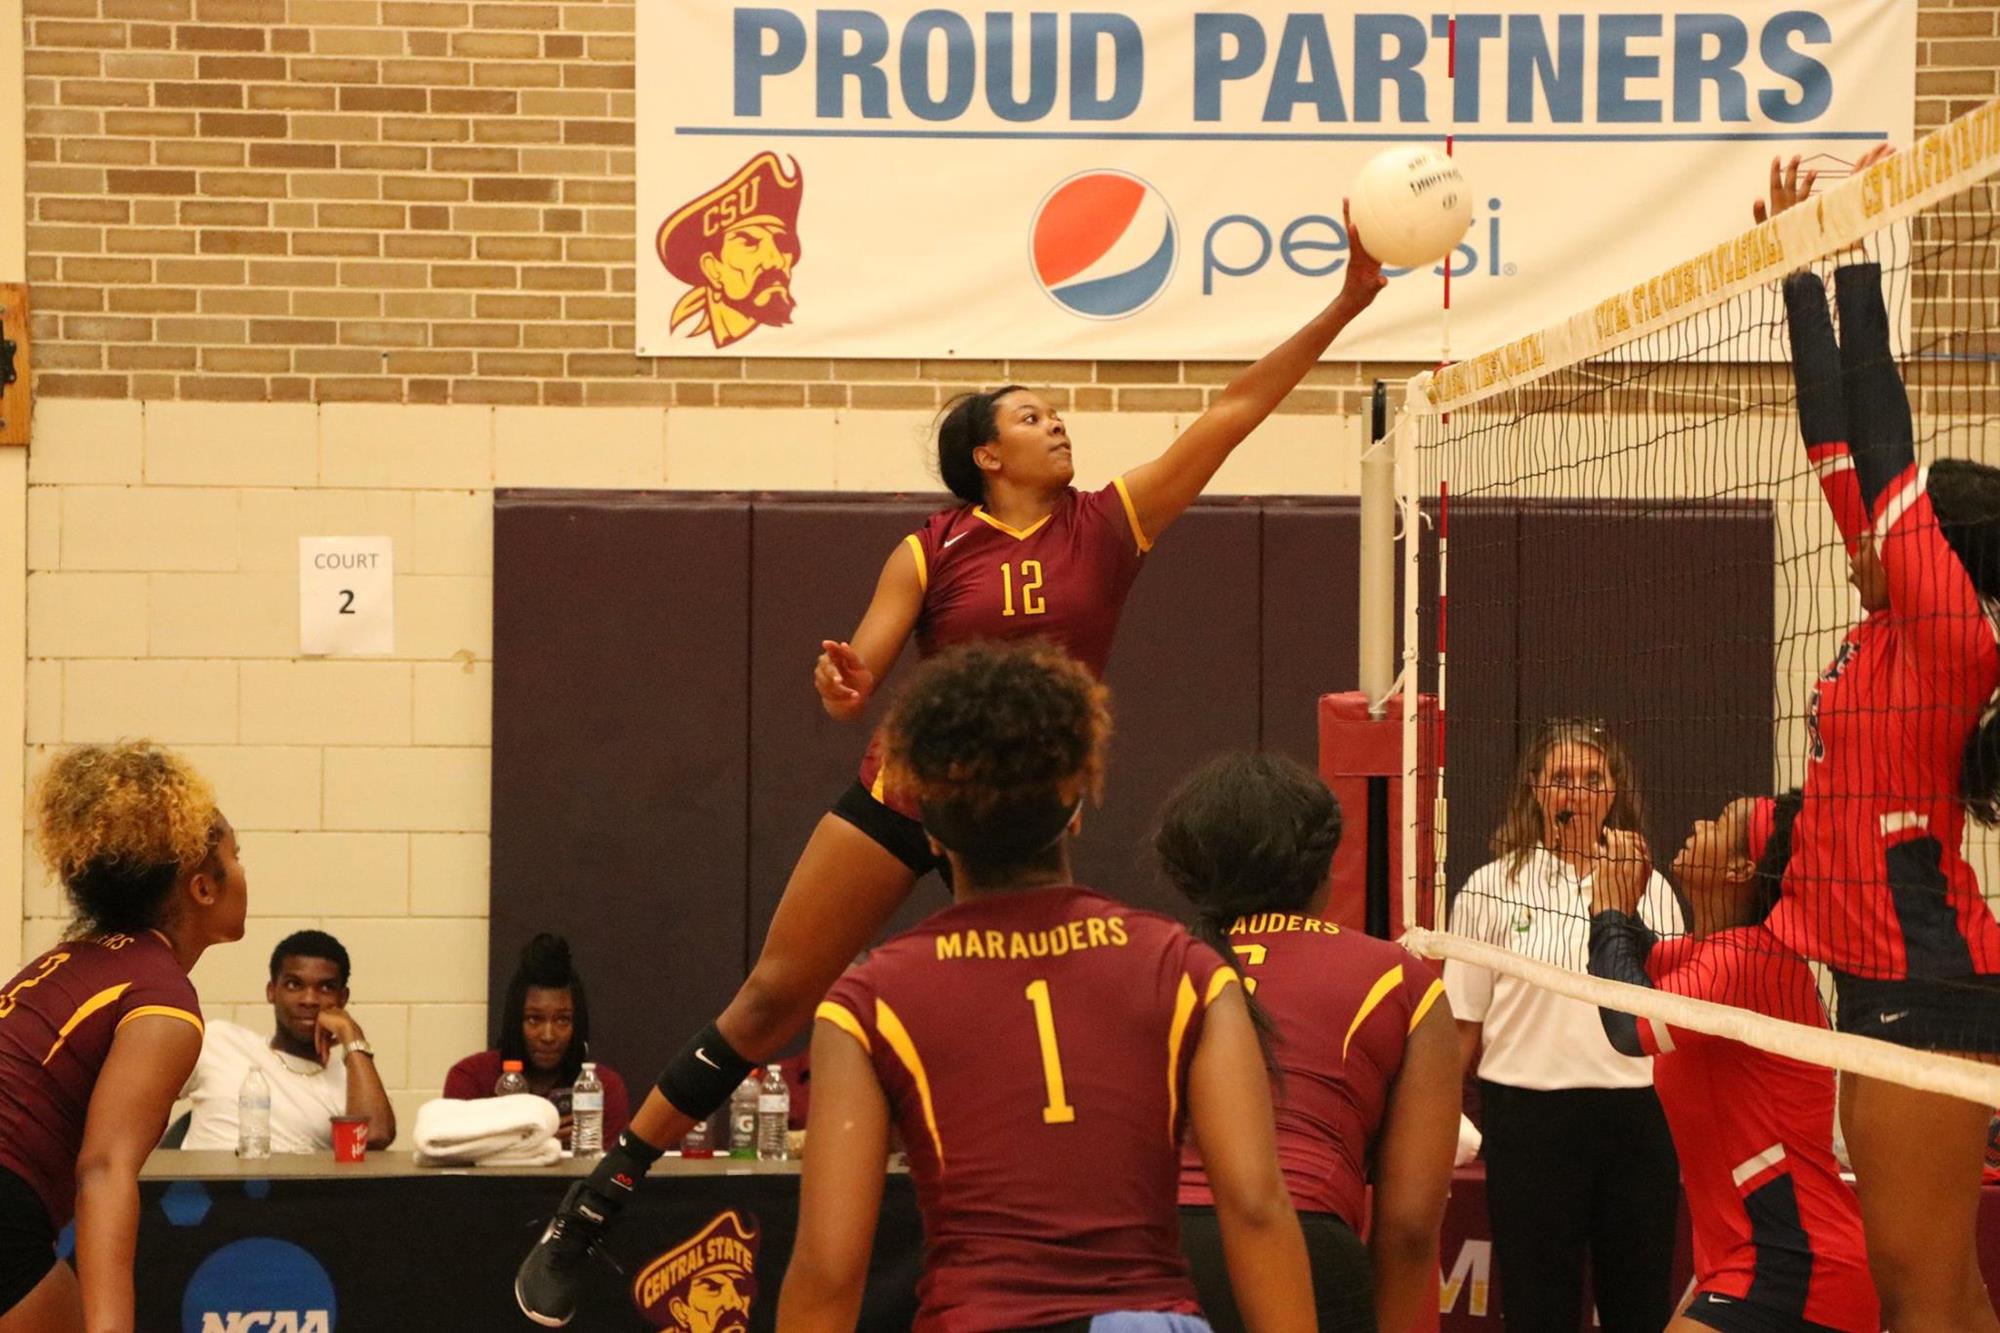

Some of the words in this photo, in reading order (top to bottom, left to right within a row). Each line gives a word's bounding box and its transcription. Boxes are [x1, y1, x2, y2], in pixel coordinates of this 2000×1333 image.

[734, 8, 1144, 121] PROUD
[1194, 11, 1833, 124] PARTNERS
[703, 176, 760, 237] CSU
[1203, 198, 1500, 295] pesi
[314, 553, 379, 569] COURT
[1001, 560, 1046, 616] 12
[338, 589, 356, 614] 2
[936, 916, 1128, 961] MARAUDERS
[1025, 979, 1075, 1124] 1
[643, 1245, 706, 1309] CENTRAL
[706, 1236, 754, 1274] STATE
